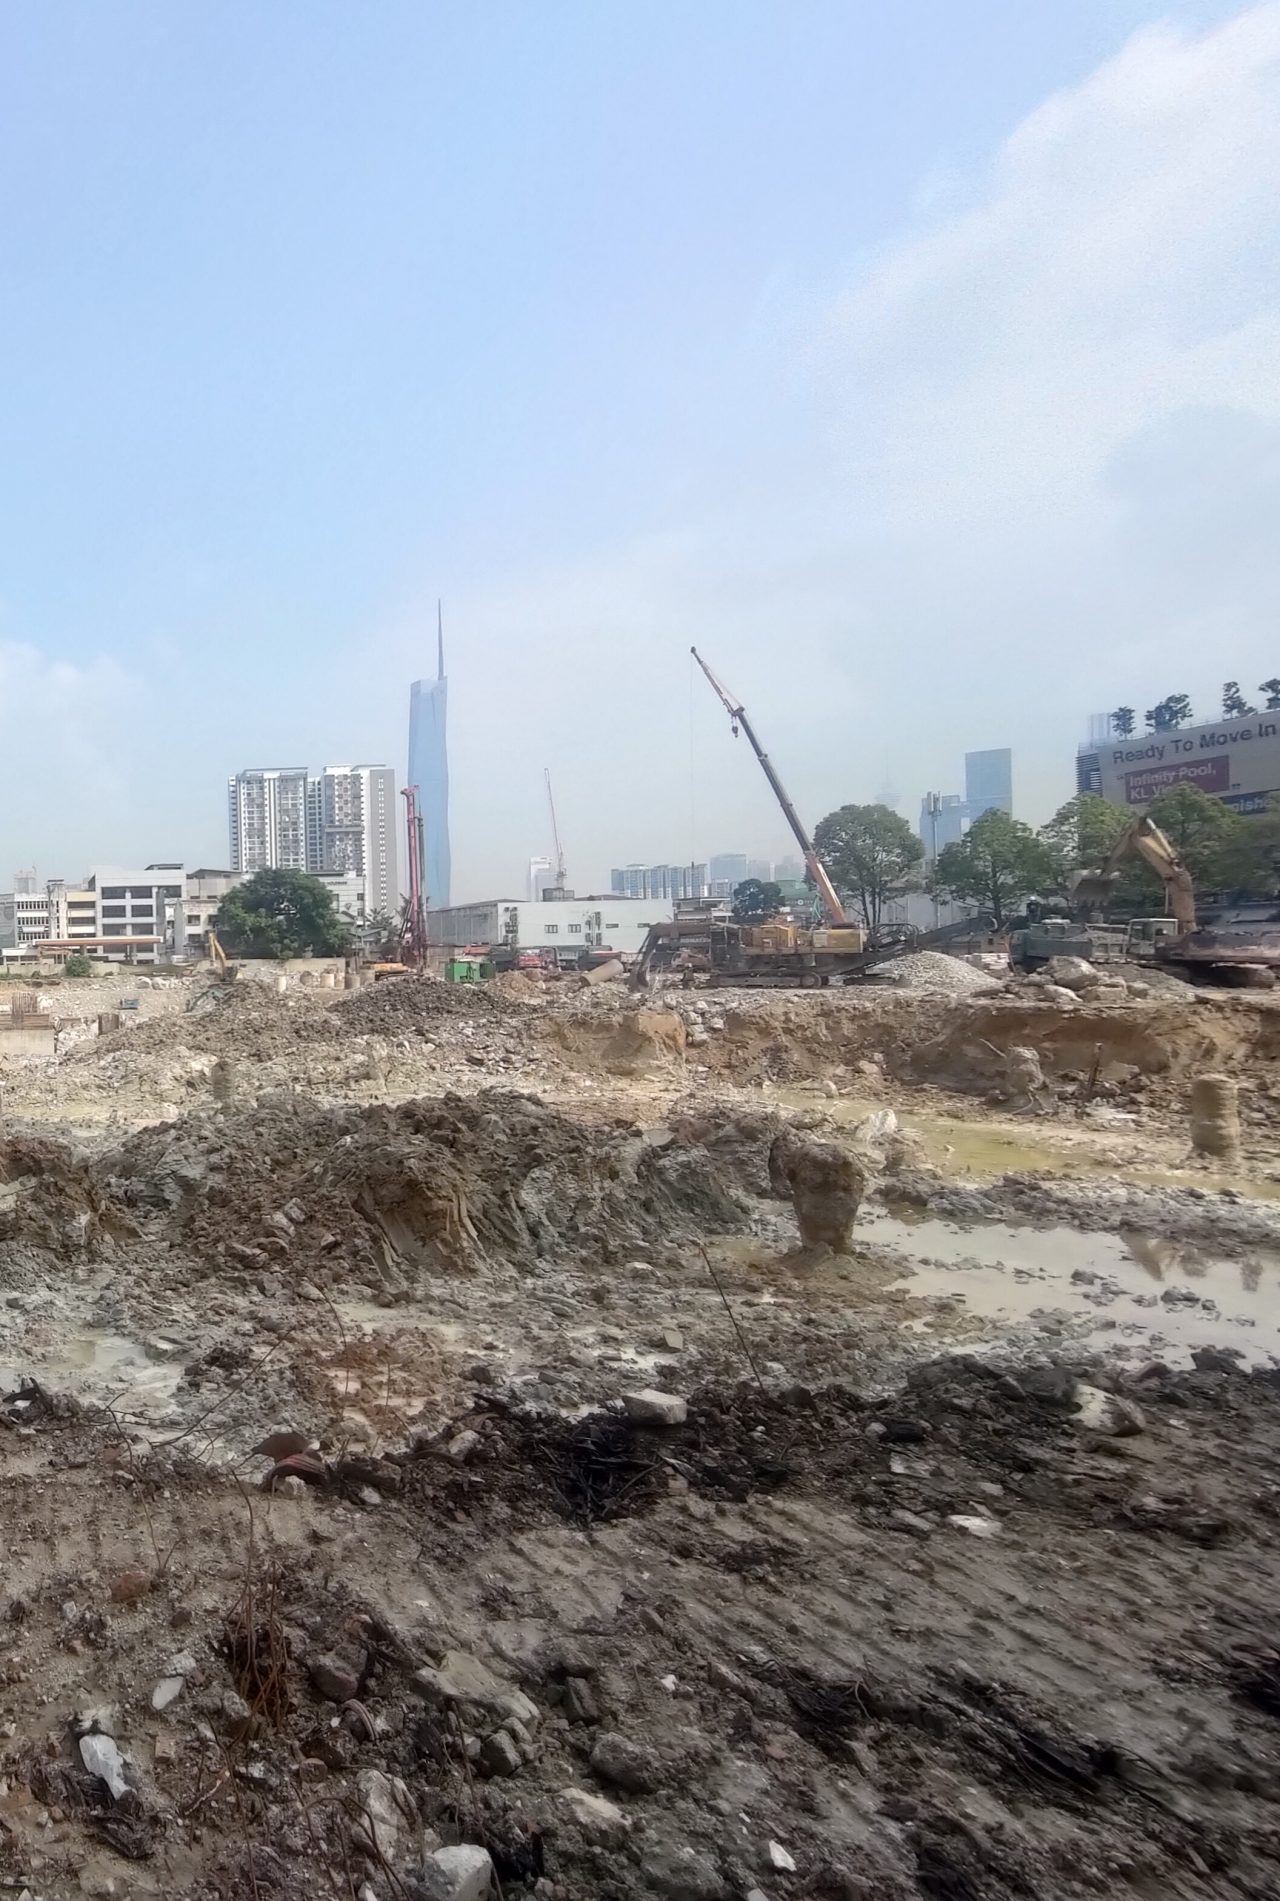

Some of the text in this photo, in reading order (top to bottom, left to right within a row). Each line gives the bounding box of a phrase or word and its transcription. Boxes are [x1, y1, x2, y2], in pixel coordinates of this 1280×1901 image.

[1113, 723, 1277, 764] Ready To Move In
[1130, 763, 1217, 786] Infinity Pool,
[1130, 786, 1149, 799] KL
